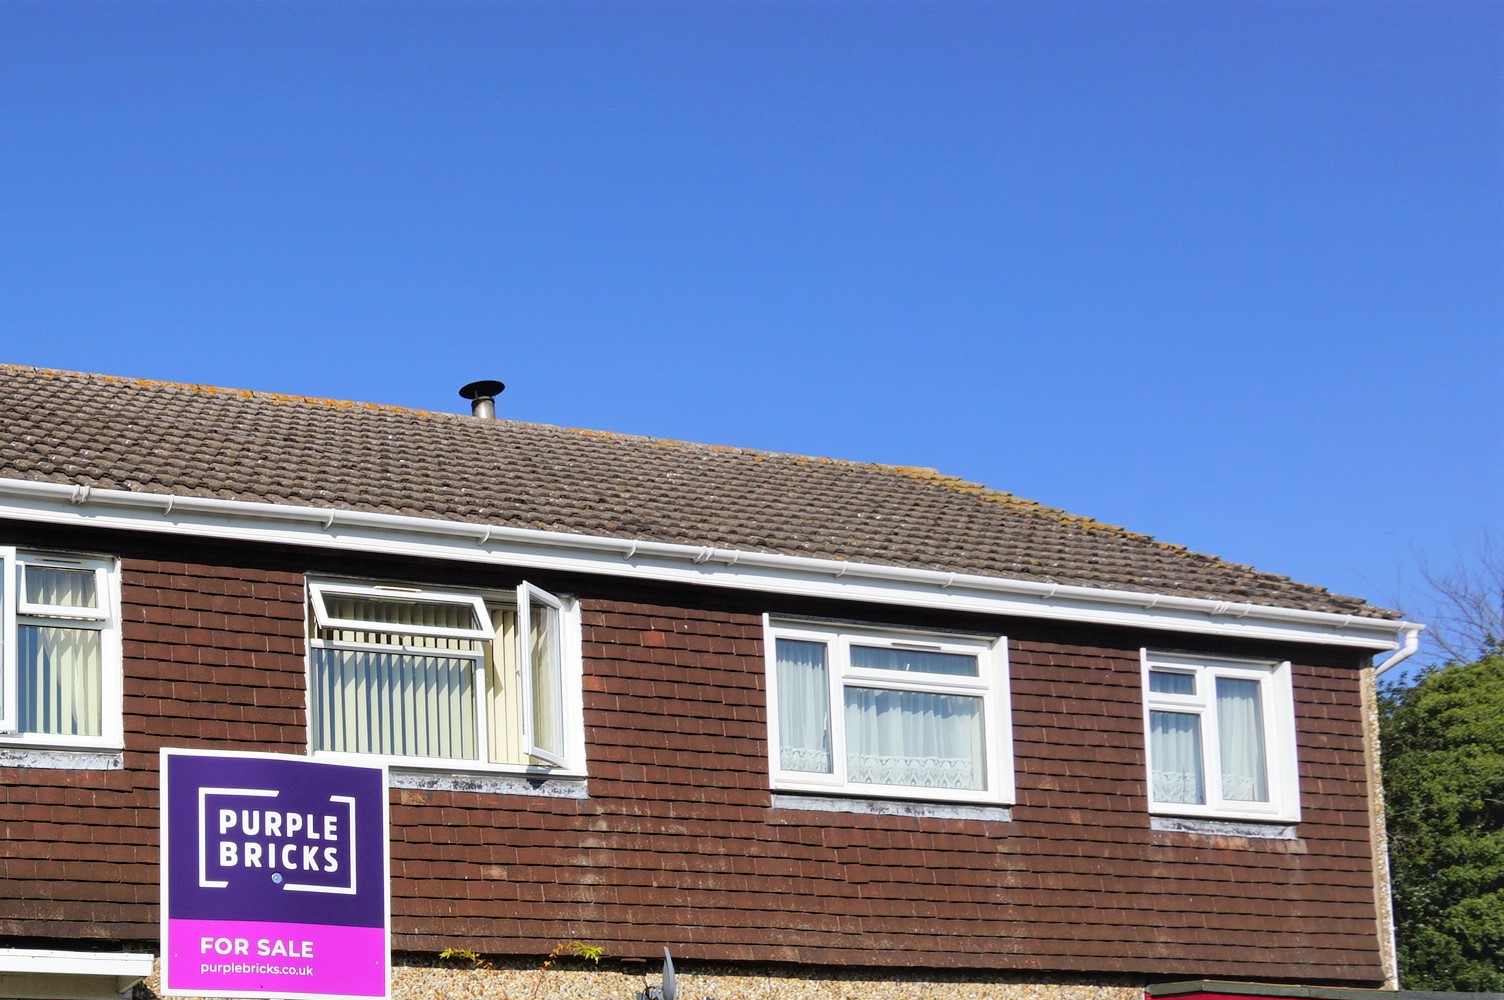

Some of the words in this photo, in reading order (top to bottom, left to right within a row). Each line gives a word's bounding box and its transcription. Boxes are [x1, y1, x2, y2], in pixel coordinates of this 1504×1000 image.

[219, 809, 338, 841] PURPLE
[219, 841, 339, 873] BRICKS
[200, 937, 249, 956] FOR
[257, 938, 314, 959] SALE
[200, 961, 314, 977] purplebricks.co.uk
